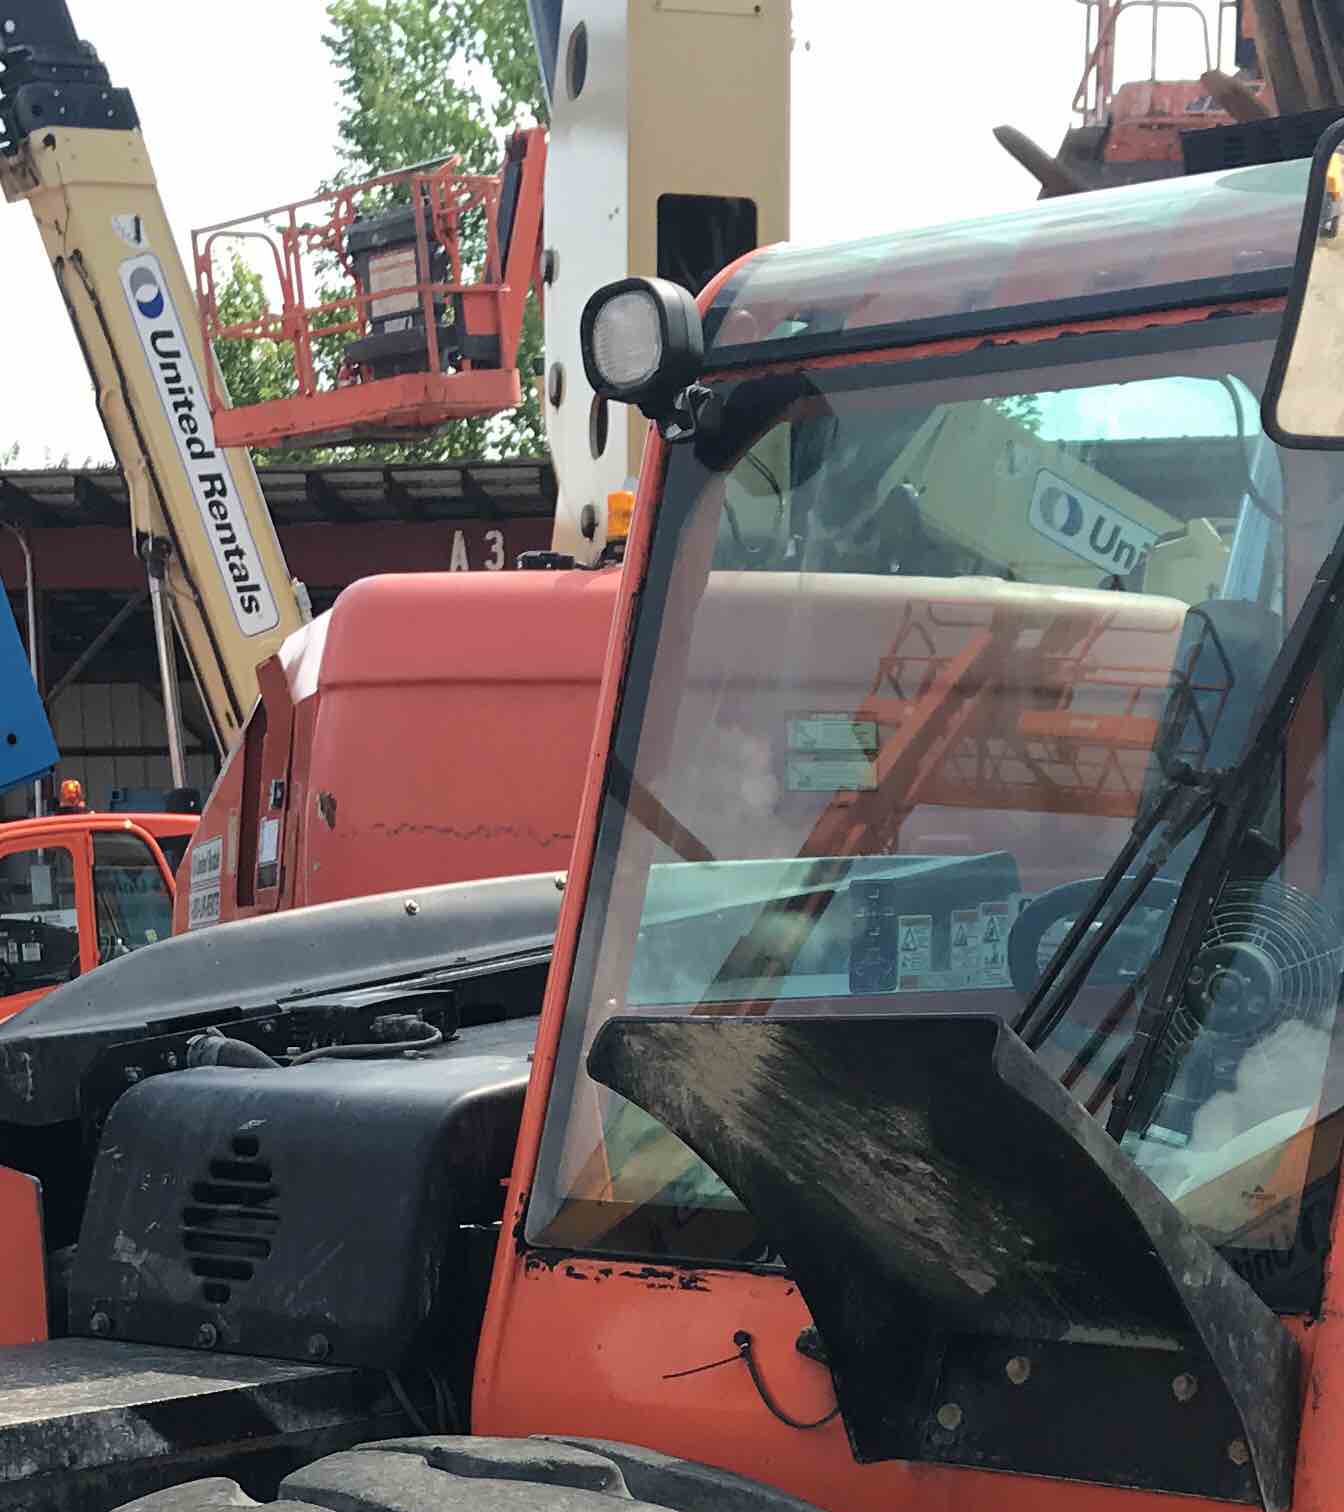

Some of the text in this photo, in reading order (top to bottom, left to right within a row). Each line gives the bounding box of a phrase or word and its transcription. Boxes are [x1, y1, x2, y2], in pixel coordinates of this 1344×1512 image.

[149, 329, 261, 617] United Rentals
[448, 528, 505, 572] A 3
